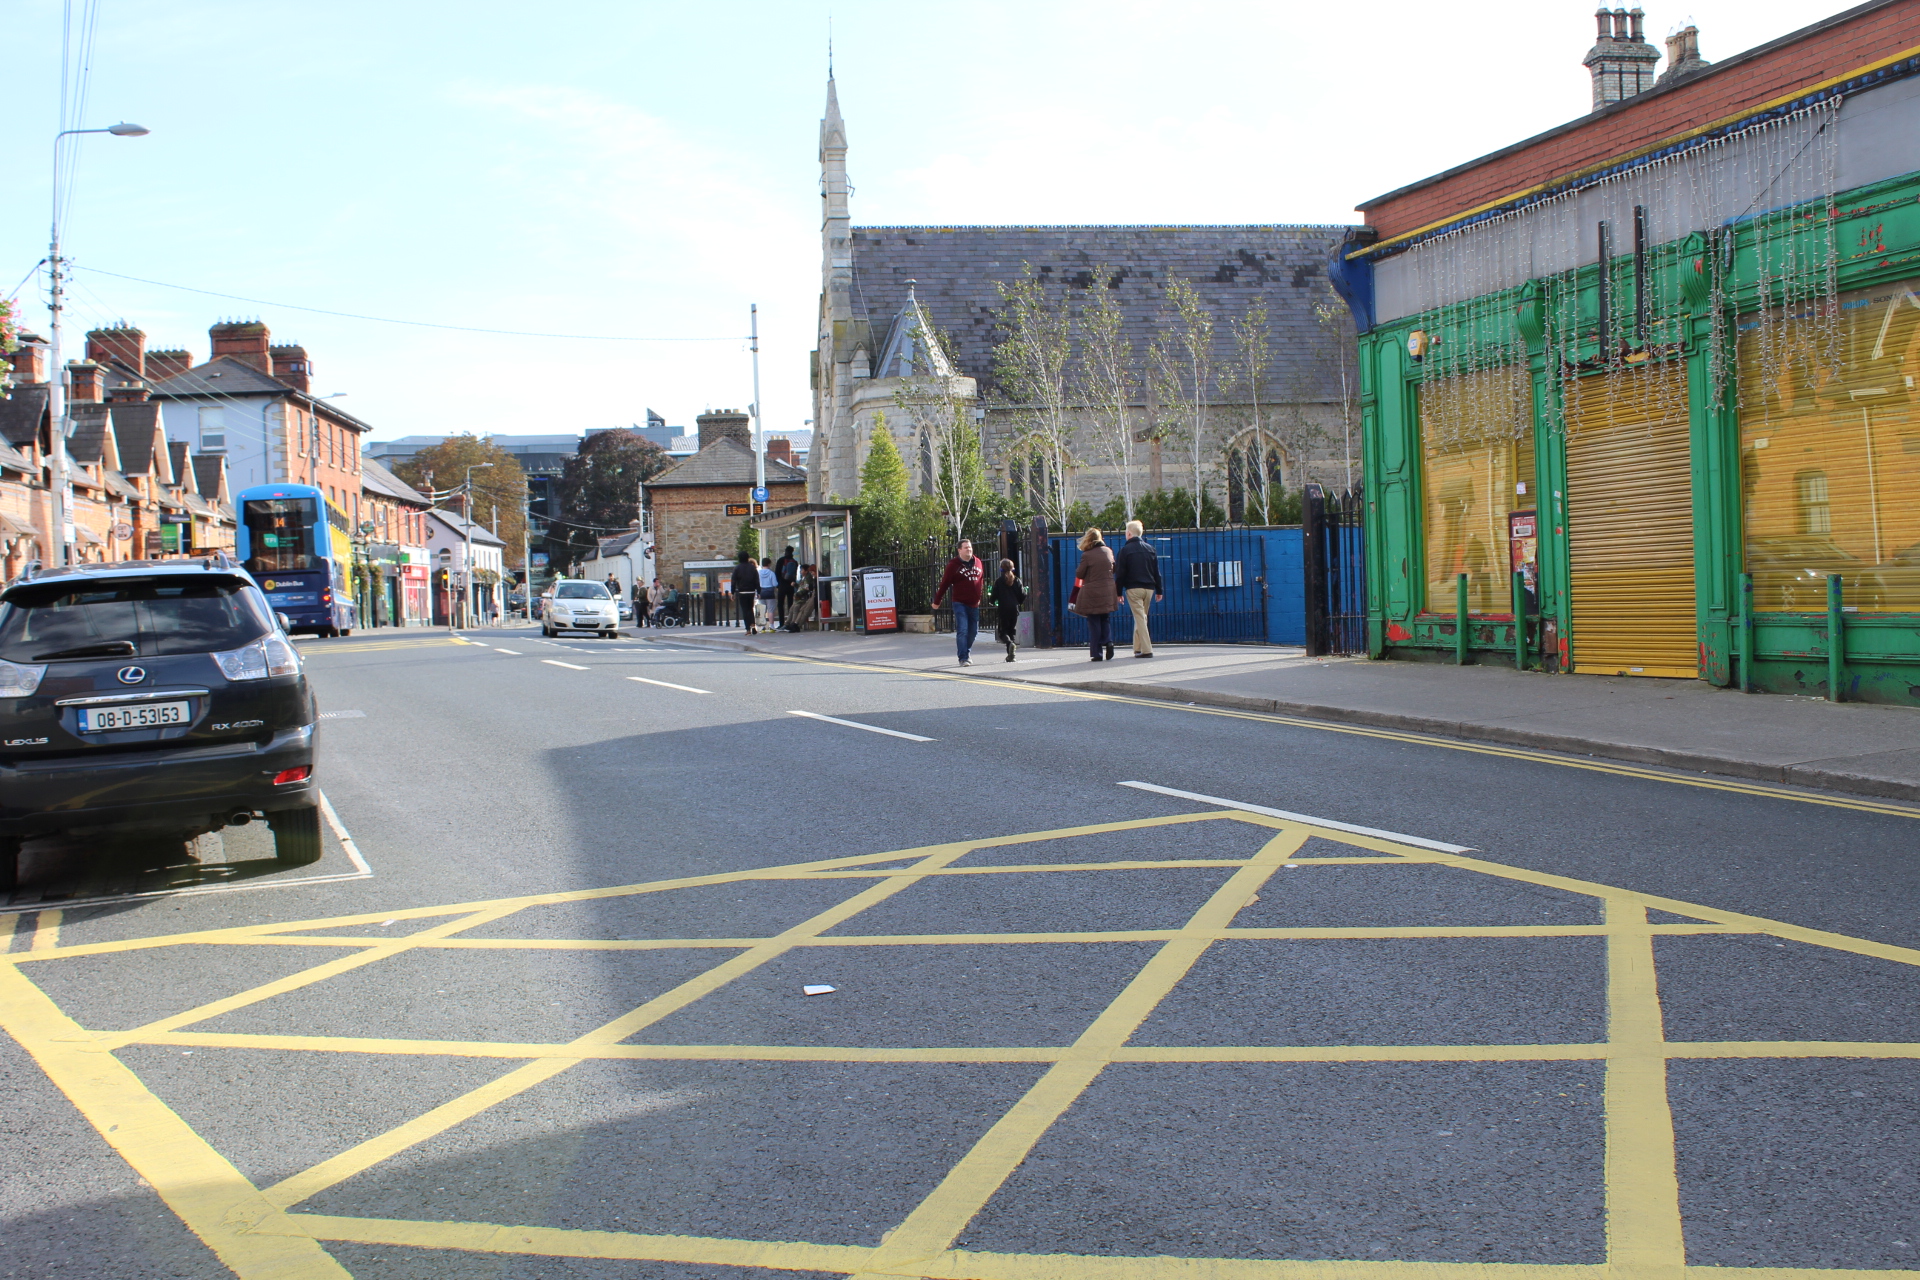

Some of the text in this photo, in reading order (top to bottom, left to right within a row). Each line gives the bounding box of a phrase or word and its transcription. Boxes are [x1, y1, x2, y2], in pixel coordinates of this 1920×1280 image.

[1842, 298, 1869, 310] PHILIPS
[275, 517, 285, 527] 14
[97, 706, 179, 728] 08-D-53153
[211, 719, 264, 731] RX 400h
[3, 736, 49, 746] LEXUS
